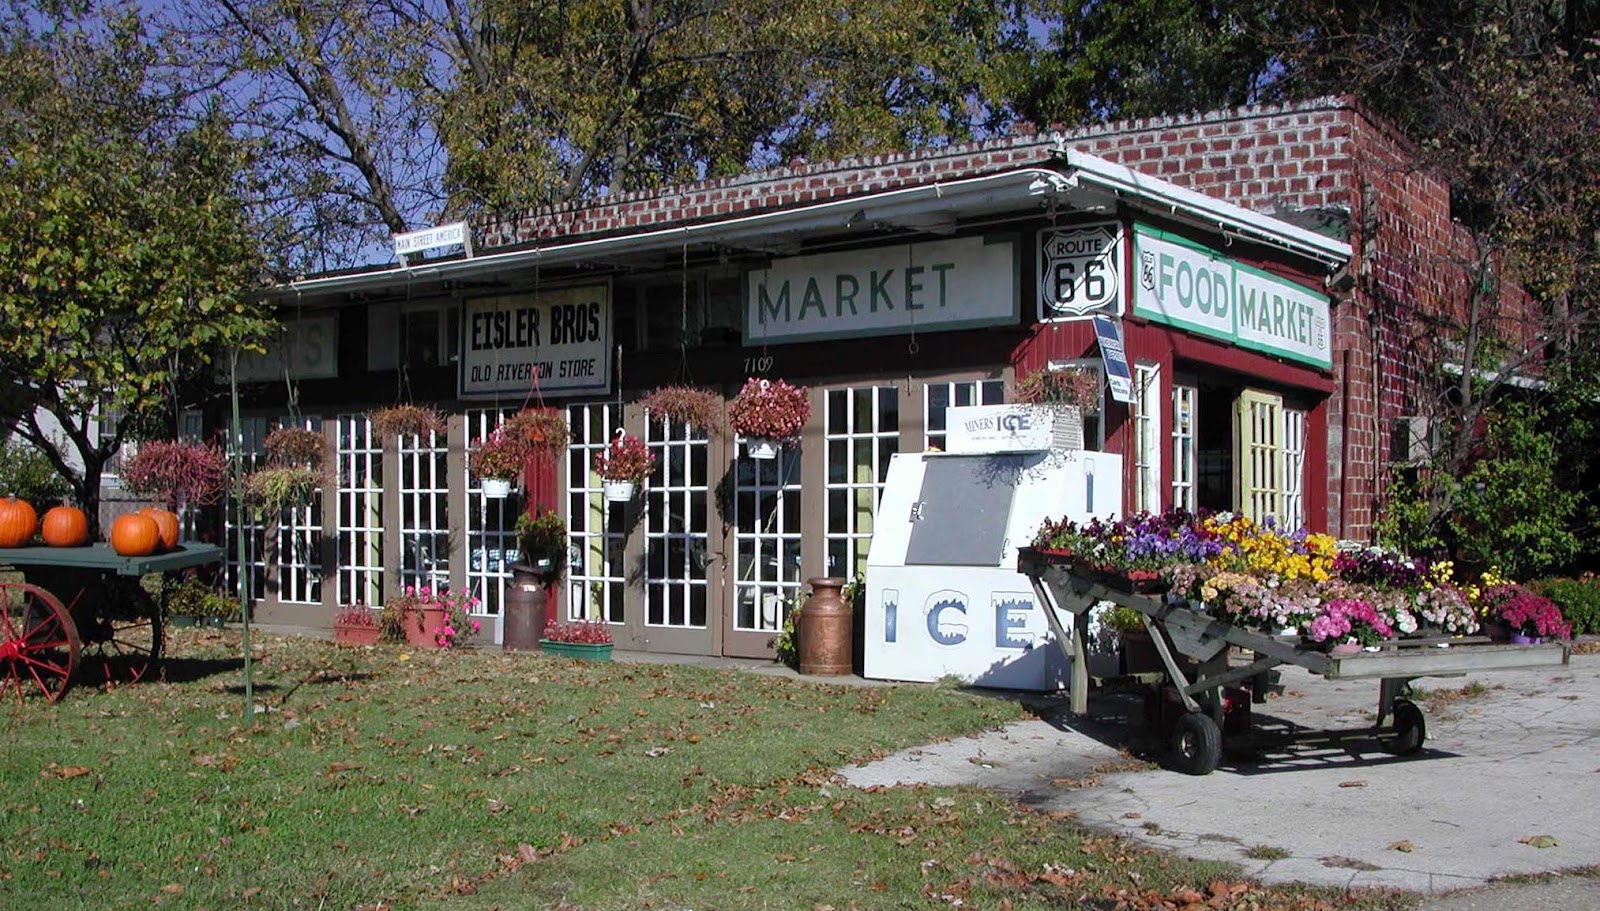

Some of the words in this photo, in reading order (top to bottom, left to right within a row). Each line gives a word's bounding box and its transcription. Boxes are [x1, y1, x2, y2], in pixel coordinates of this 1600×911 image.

[413, 233, 433, 248] STREET
[436, 228, 462, 242] AMERICA
[1057, 239, 1102, 255] ROUTE
[758, 263, 955, 325] MARKET
[1055, 260, 1105, 303] 66
[1159, 252, 1229, 318] FOOD
[1240, 284, 1314, 347] MARKET
[471, 307, 540, 351] EISLER
[550, 302, 601, 345] BROS.
[471, 364, 492, 382] OLD
[559, 358, 596, 378] STORE
[744, 356, 774, 373] 7109
[996, 412, 1031, 431] ICE
[881, 588, 1036, 650] ICE
